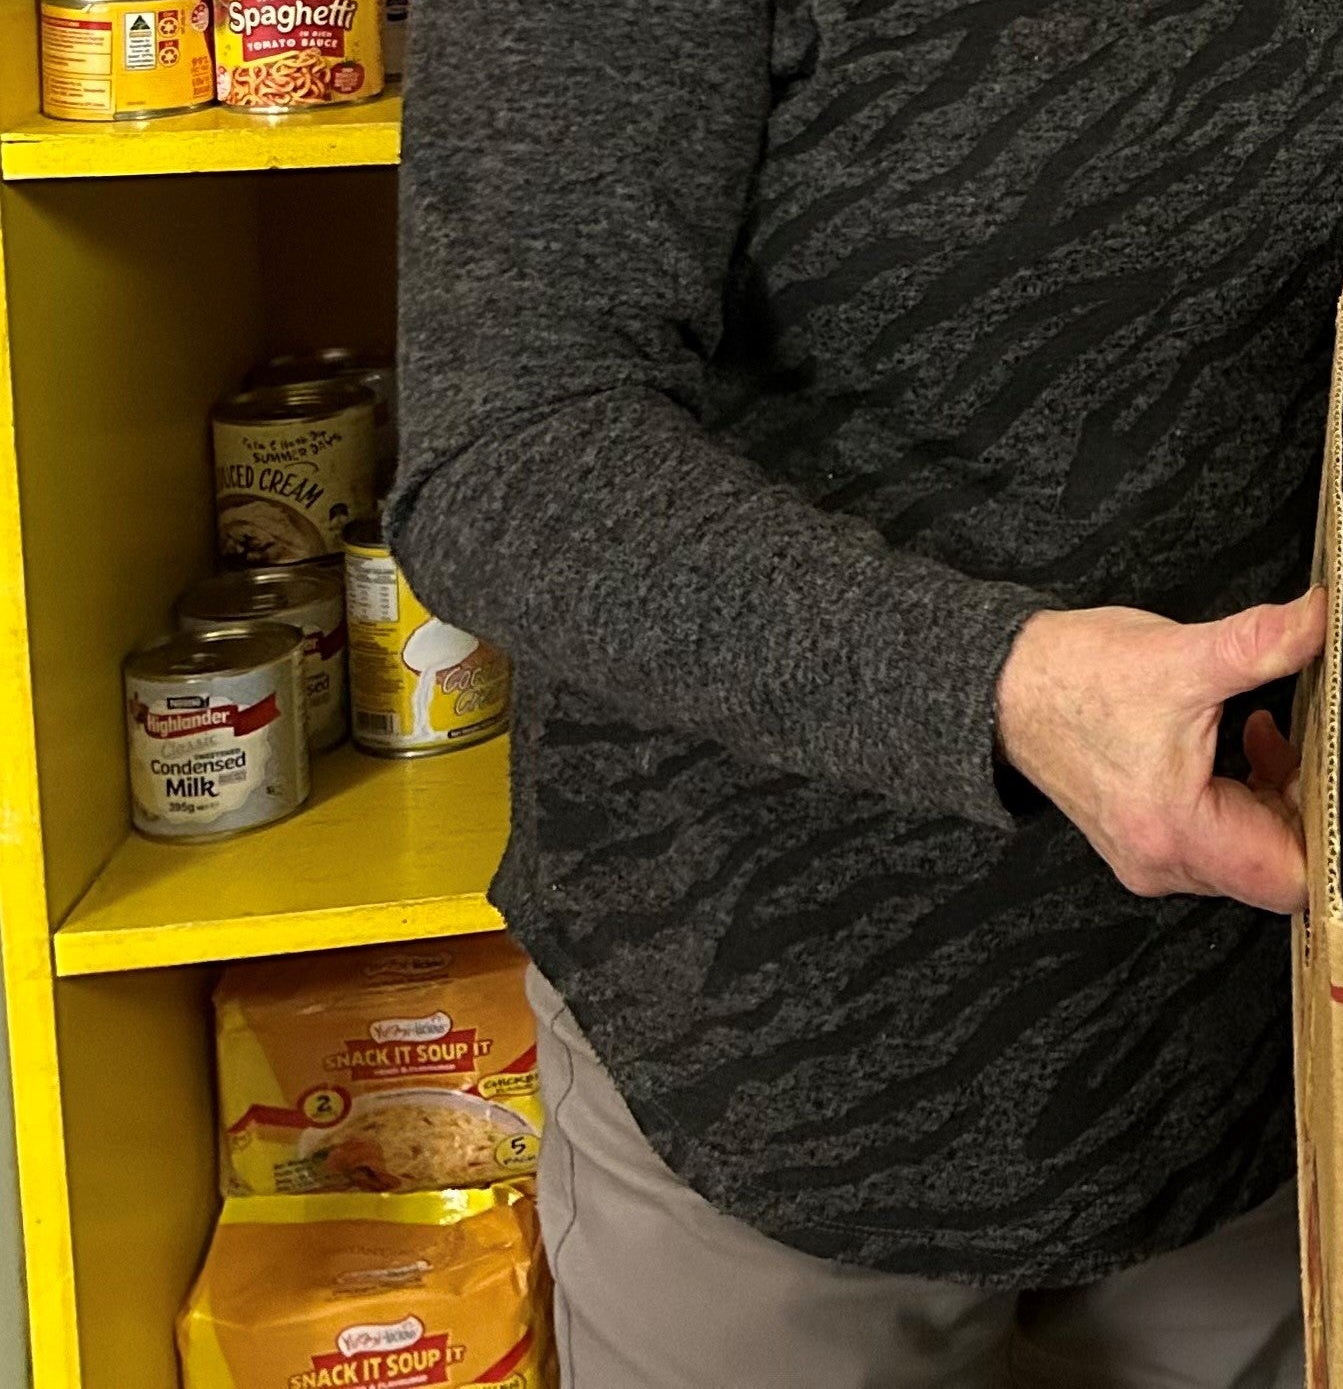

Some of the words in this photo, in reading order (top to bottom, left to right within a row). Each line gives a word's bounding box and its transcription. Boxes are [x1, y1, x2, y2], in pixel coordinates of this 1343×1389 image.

[246, 39, 297, 52] TOMATO
[301, 39, 339, 49] SAUCE
[259, 467, 326, 510] CREAM
[147, 710, 231, 738] Highlander
[151, 751, 246, 776] Condensed
[165, 776, 220, 799] Milk
[323, 1043, 389, 1069] SNACK
[394, 1044, 412, 1064] IT
[417, 1039, 469, 1062] SOUP
[471, 1038, 493, 1058] IT
[316, 1094, 332, 1113] 2
[511, 1137, 527, 1155] 5
[363, 1355, 382, 1379] IT
[386, 1347, 442, 1374] SOUP
[445, 1345, 466, 1364] IT
